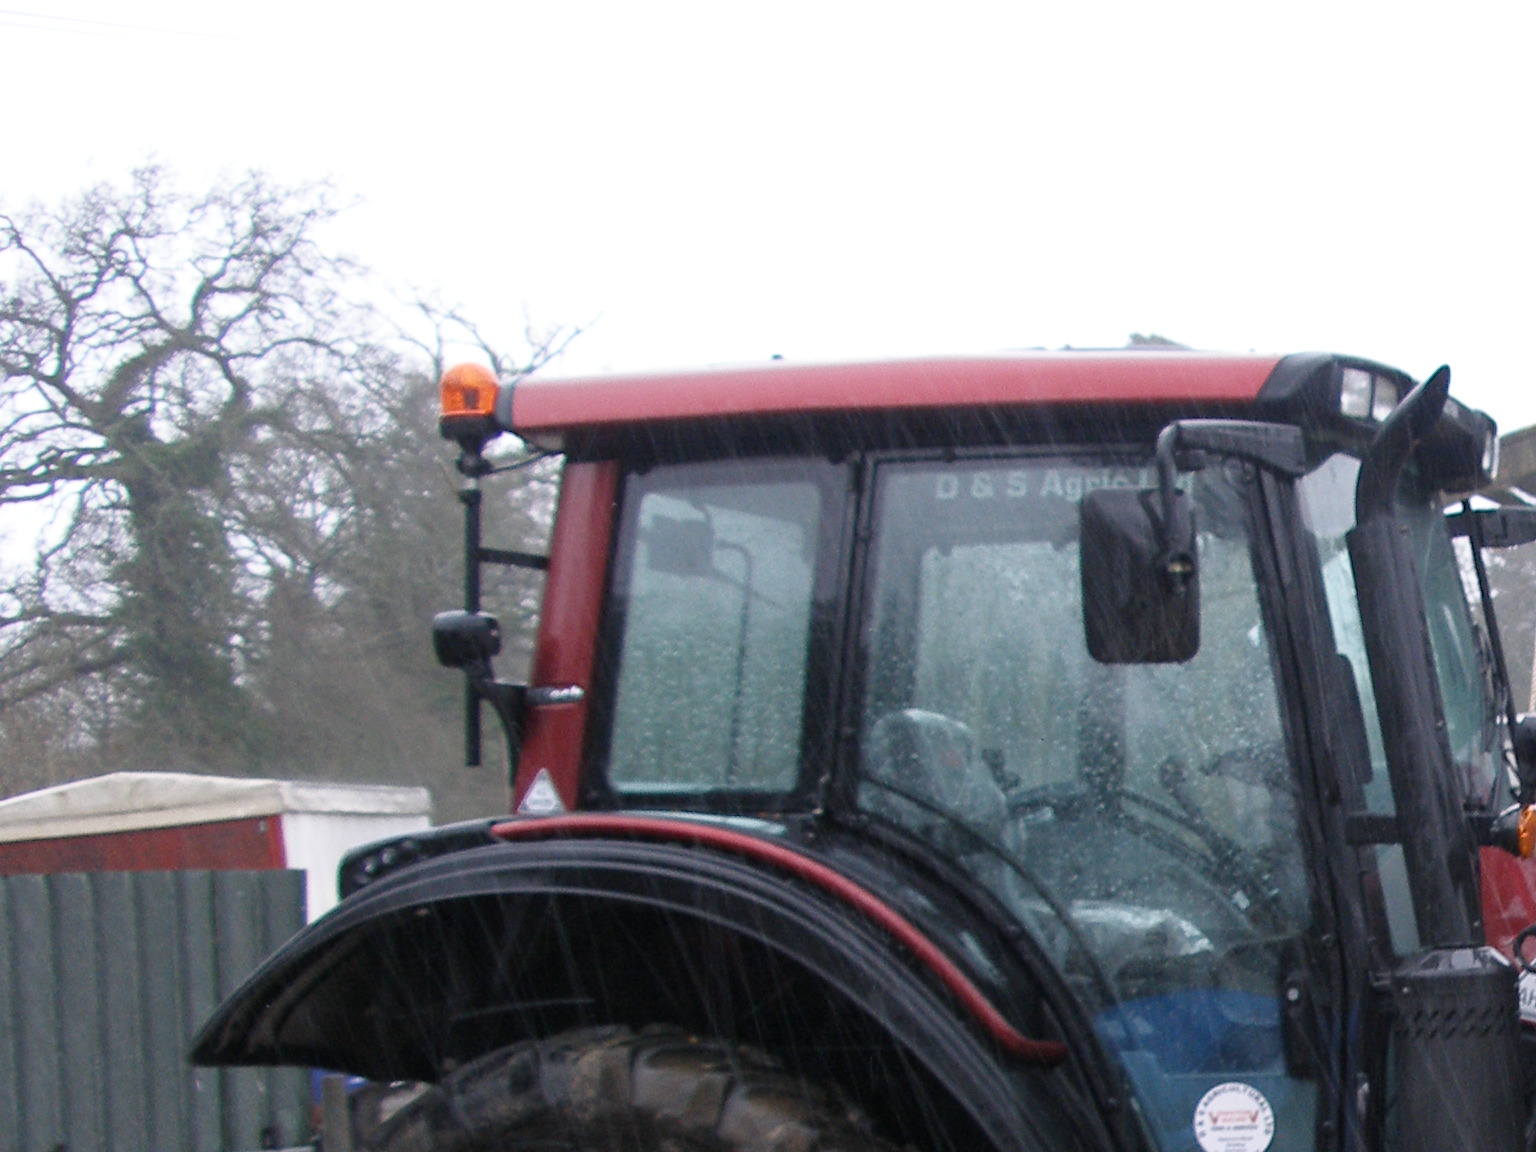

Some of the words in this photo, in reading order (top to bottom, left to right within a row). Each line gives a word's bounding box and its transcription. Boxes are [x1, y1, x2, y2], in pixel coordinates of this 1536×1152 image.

[936, 473, 958, 499] D
[971, 471, 994, 497] &
[1006, 470, 1028, 496] S
